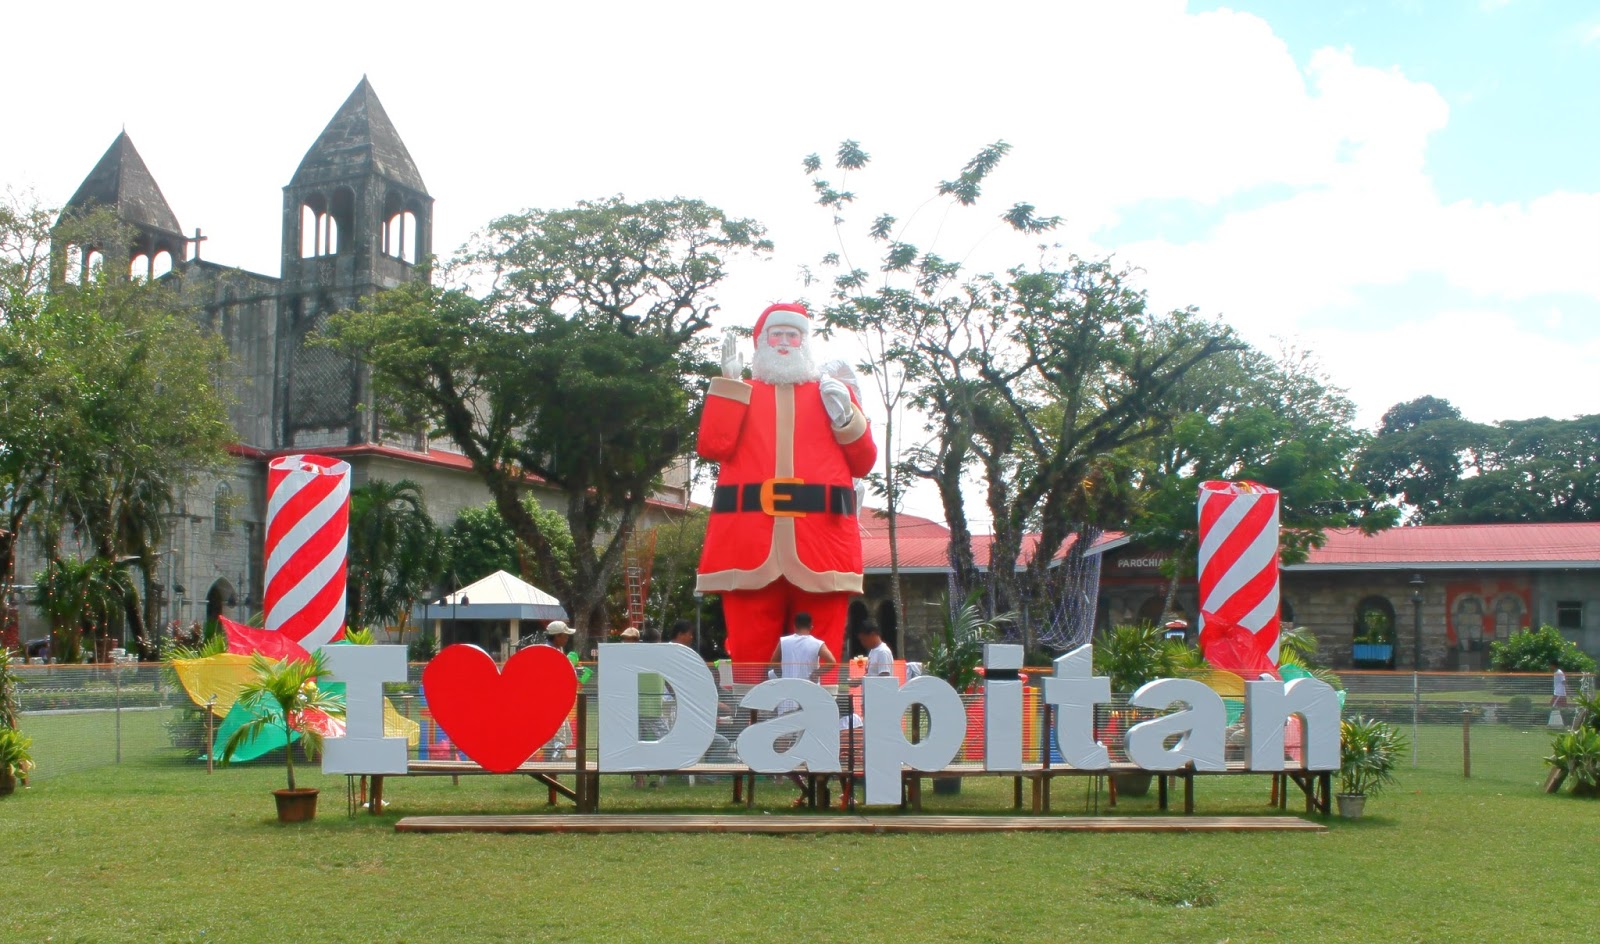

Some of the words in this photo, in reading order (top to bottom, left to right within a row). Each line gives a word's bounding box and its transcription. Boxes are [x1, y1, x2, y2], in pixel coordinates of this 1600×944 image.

[1117, 558, 1168, 568] PAROCHIA
[322, 645, 409, 775] I
[597, 642, 1342, 806] Dapitan
